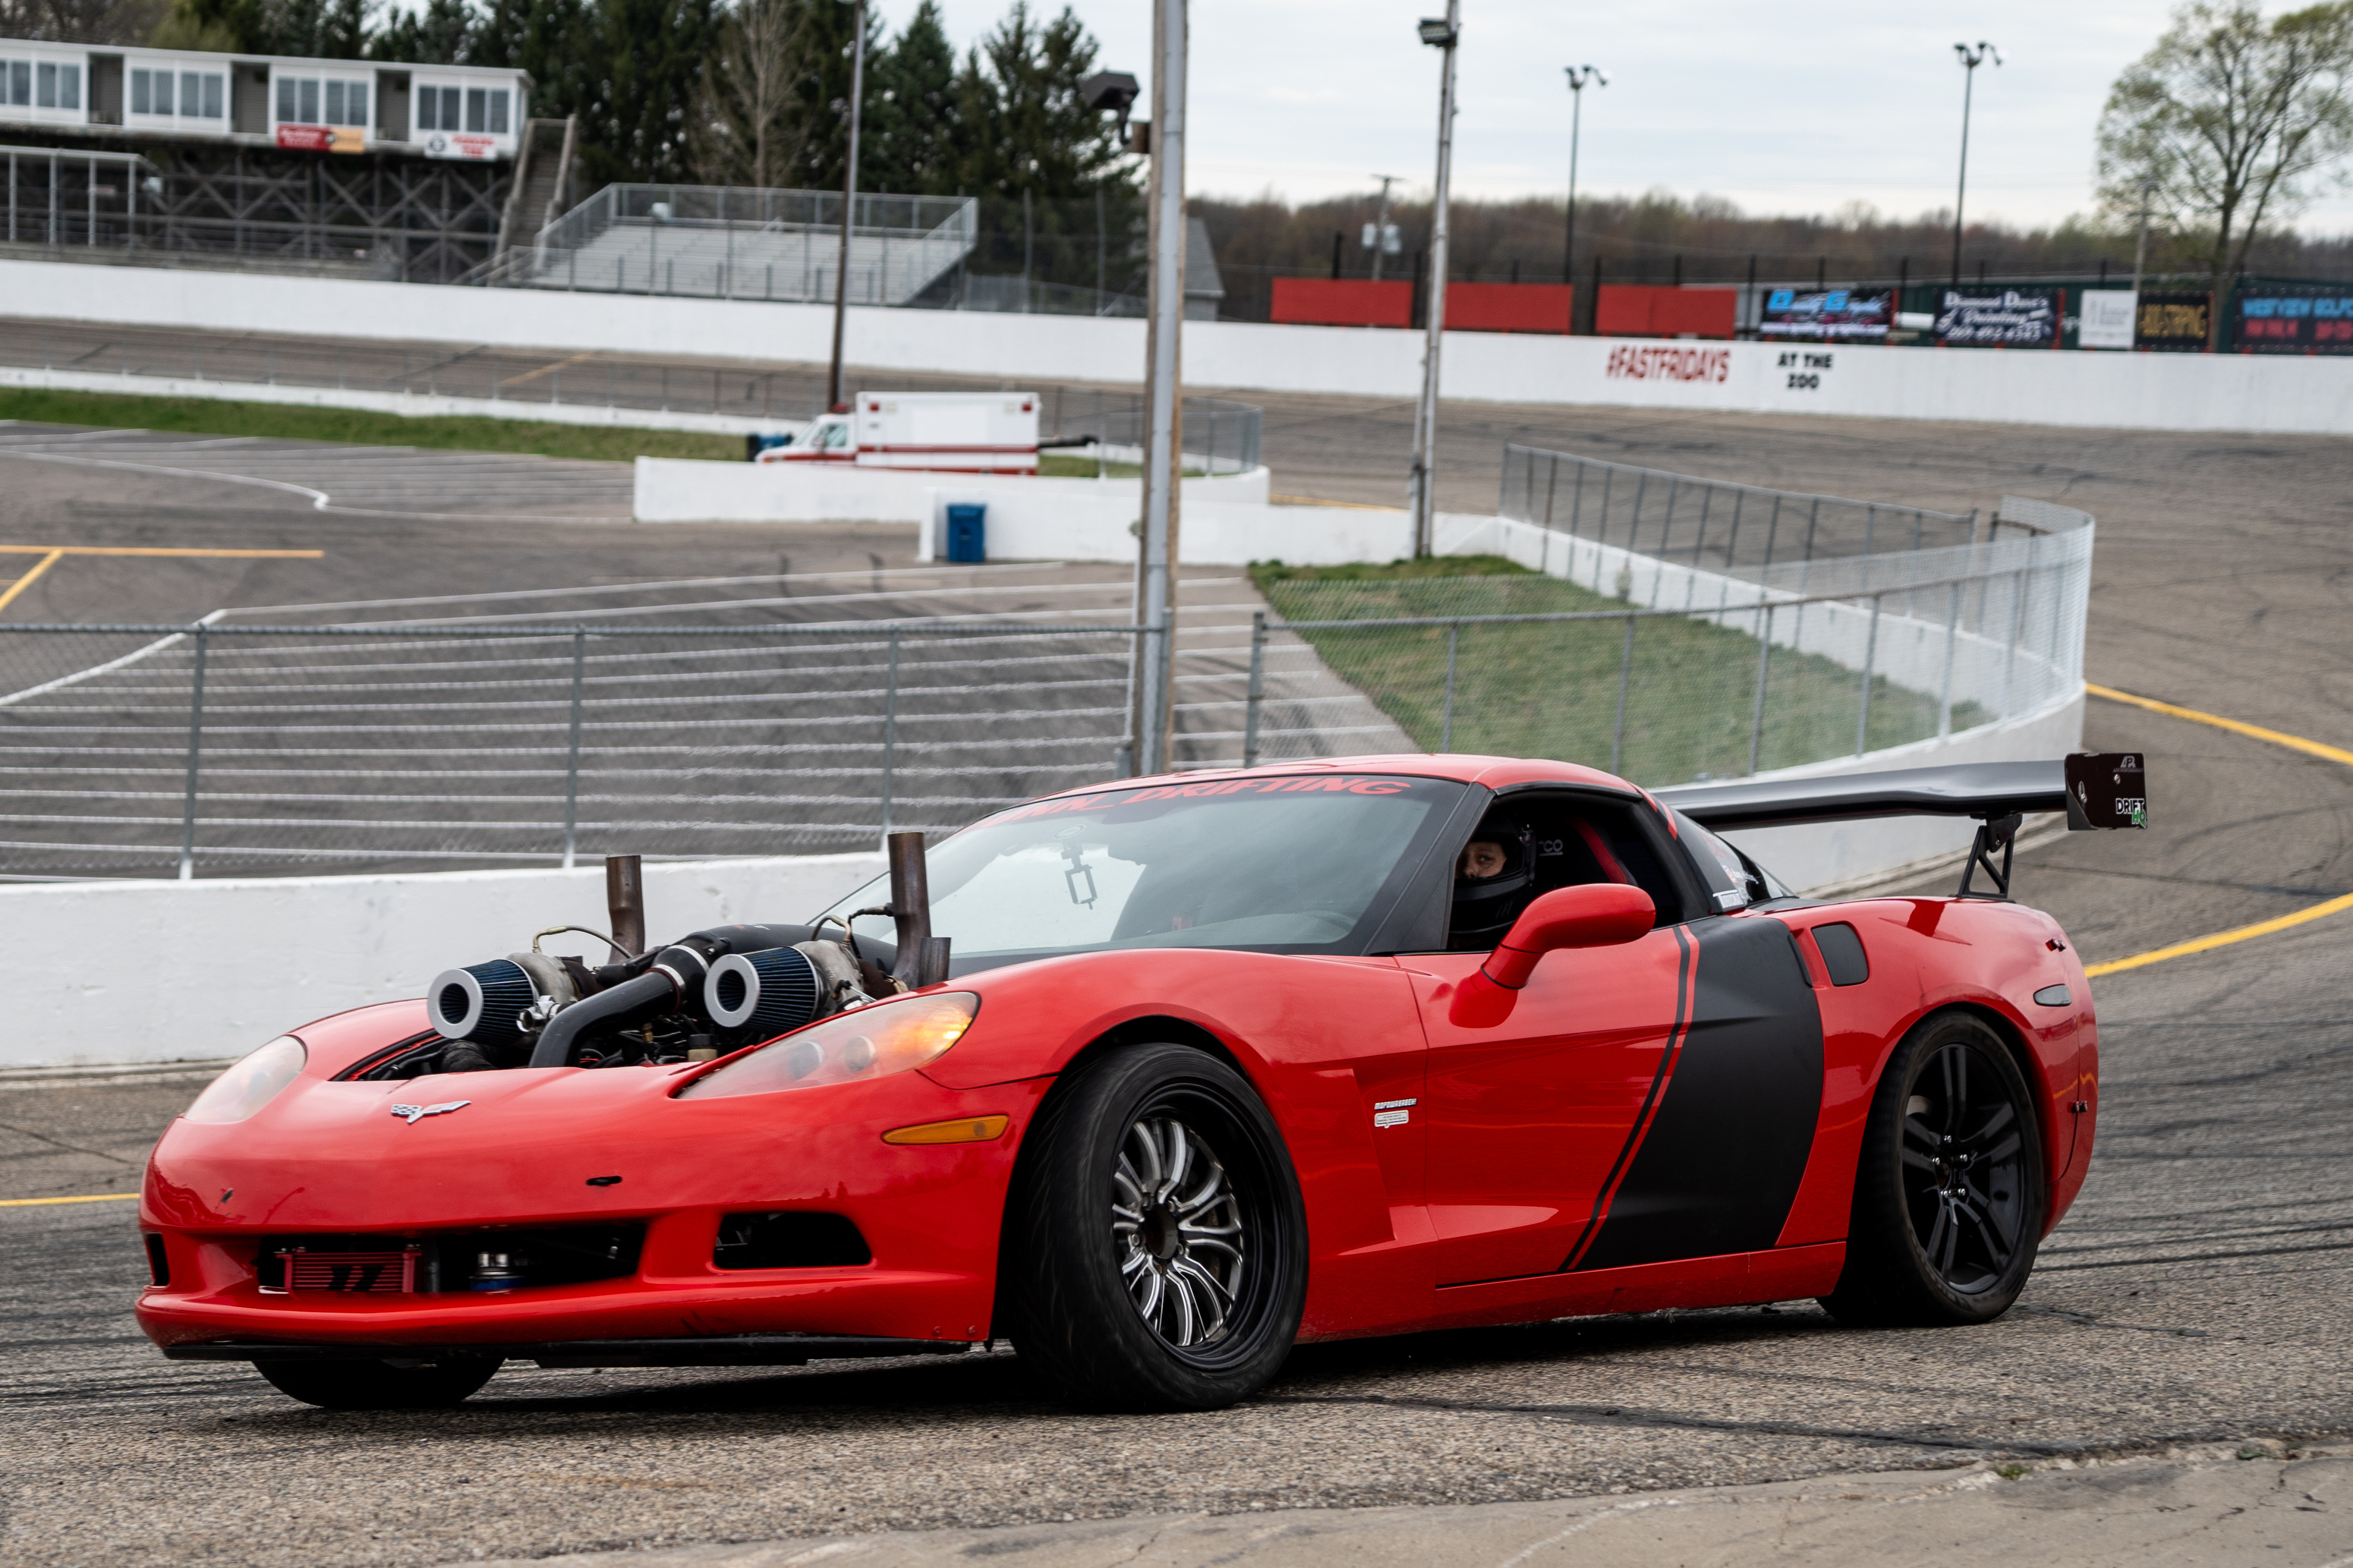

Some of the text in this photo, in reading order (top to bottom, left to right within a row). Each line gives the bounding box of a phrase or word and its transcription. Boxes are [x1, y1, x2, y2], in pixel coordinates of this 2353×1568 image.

[1606, 345, 1730, 382] #FASTFRIDAYS
[1778, 351, 1833, 369] AT THE
[1787, 373, 1819, 389] ZOO
[2115, 798, 2145, 814] DRIFT
[2131, 810, 2147, 829] HQ
